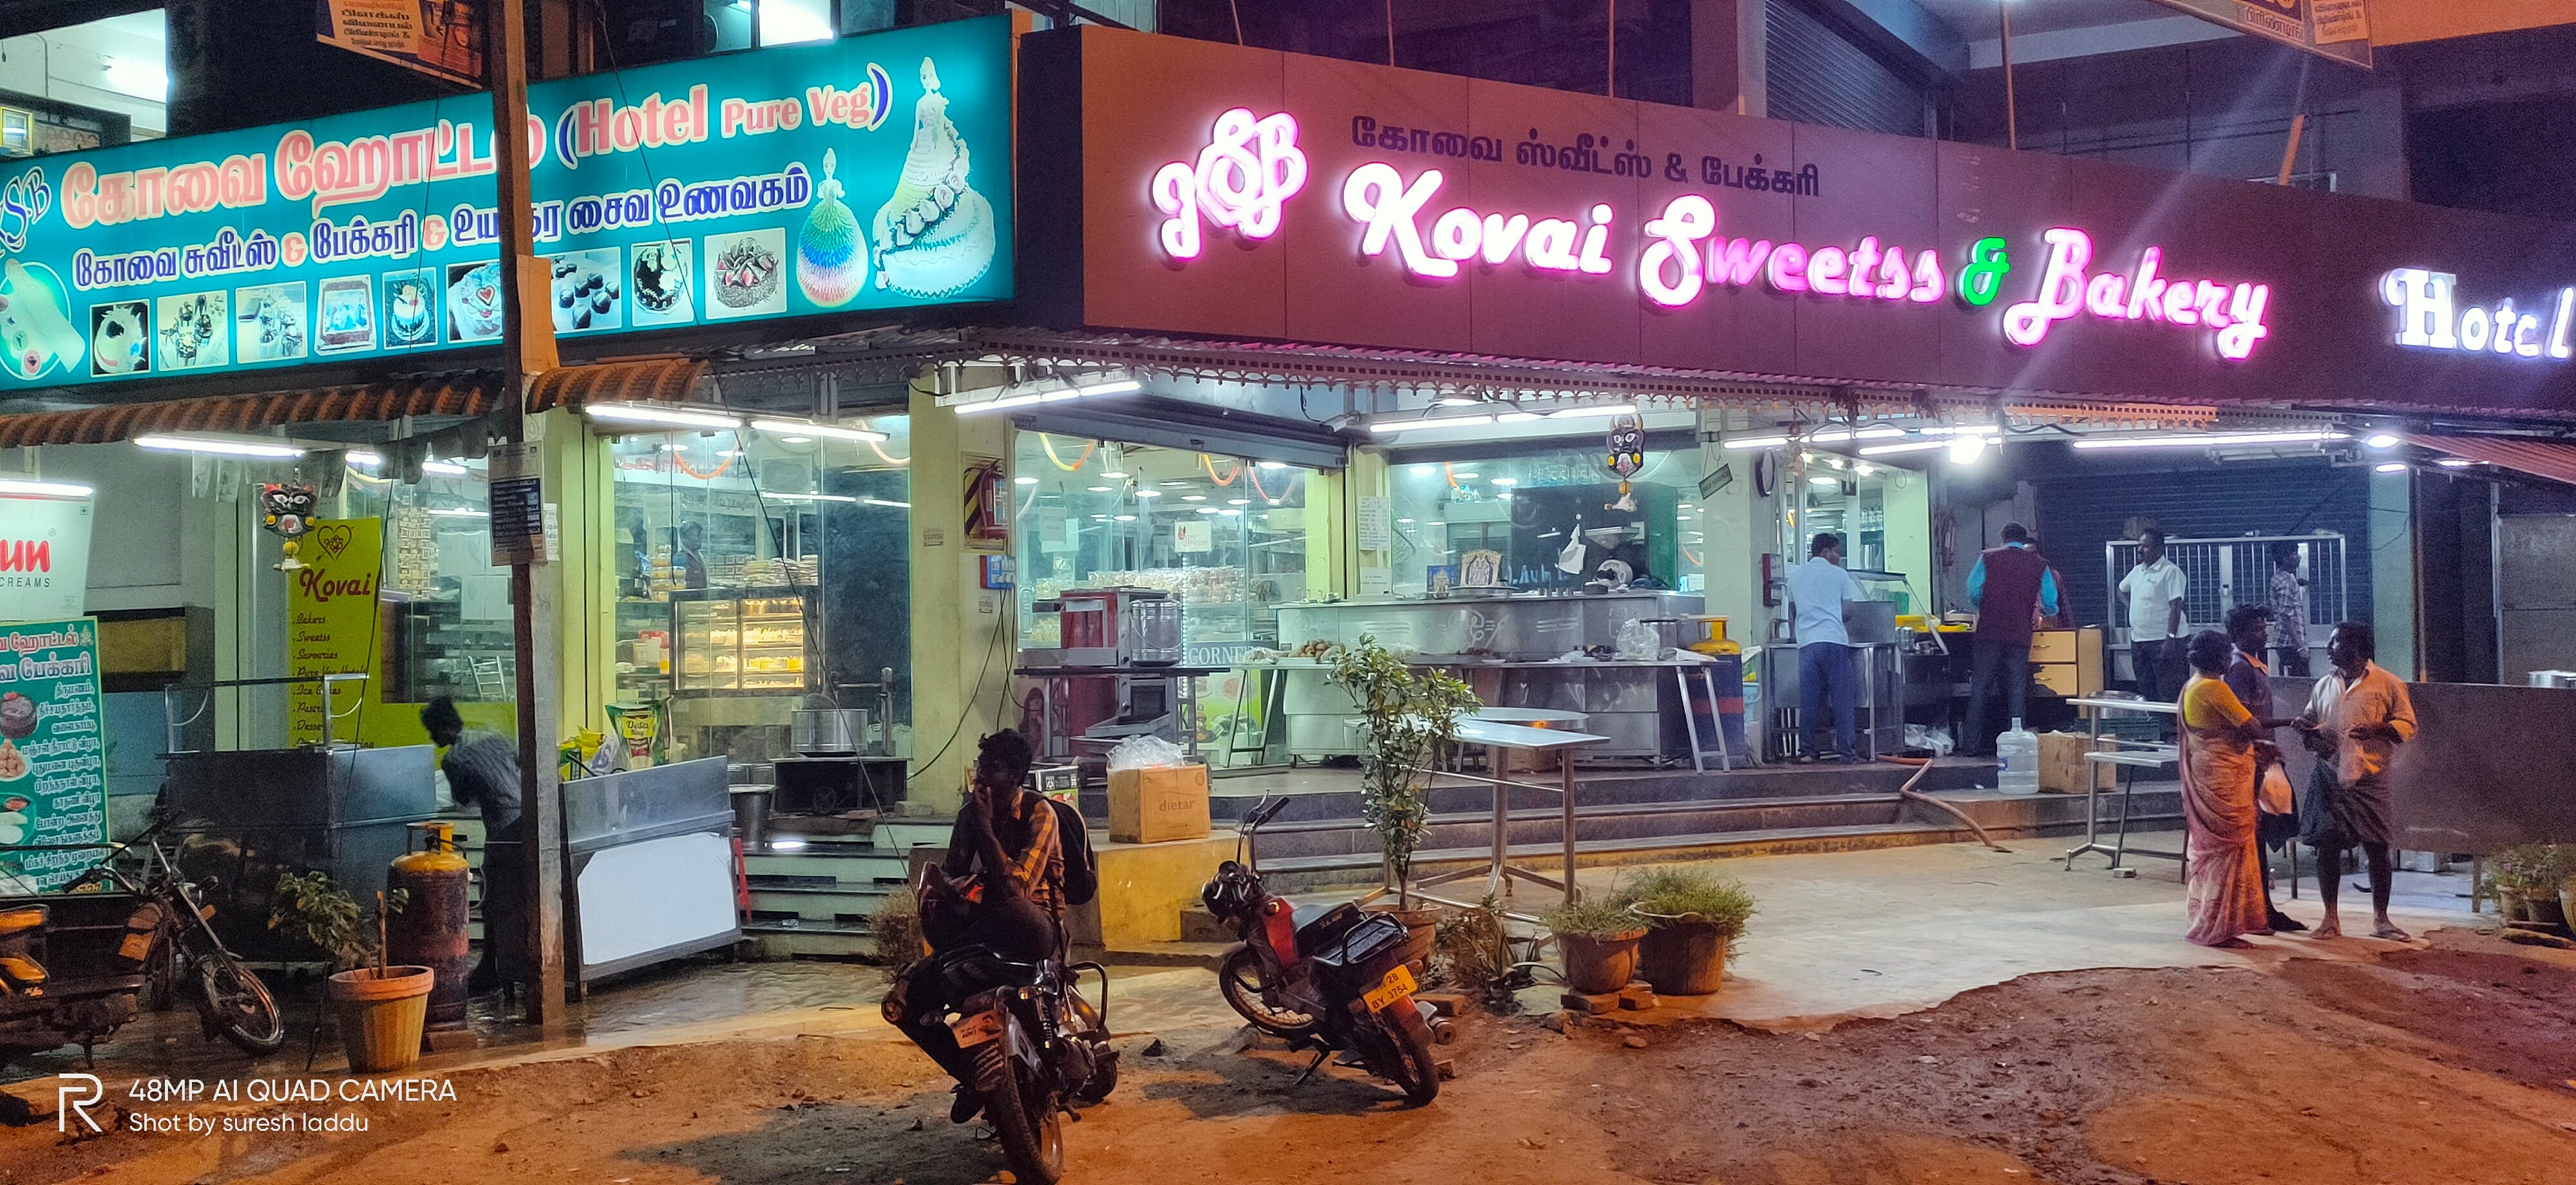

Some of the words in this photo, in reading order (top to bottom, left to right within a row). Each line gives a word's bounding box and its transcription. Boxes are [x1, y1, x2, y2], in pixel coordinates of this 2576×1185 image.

[556, 84, 708, 169] (Hotel
[721, 97, 802, 138] Pure
[806, 62, 893, 132] Veg)
[1352, 115, 1502, 162] கோவை
[1516, 128, 1653, 178] ஸ்வீட்ஸ்
[1664, 153, 1688, 184] &
[1701, 153, 1820, 197] பேக்கரி
[61, 153, 266, 229] கோவை
[73, 247, 180, 291] கோவை
[281, 232, 308, 267] &
[310, 209, 417, 263] பேக்கரி
[421, 214, 448, 250] &
[565, 189, 653, 230] சைவ
[656, 161, 812, 223] உணவகம்
[1343, 161, 1614, 278] Kovai
[1639, 194, 1946, 307] Sweetss
[1956, 236, 2010, 306] &
[2003, 227, 2269, 360] Bakery
[299, 568, 371, 602] Kovai
[10, 623, 79, 657] ஹோட்டல்
[1188, 647, 1251, 665] CORNE
[627, 721, 649, 729] Dosa
[1387, 973, 1399, 984] 28
[1372, 996, 1385, 1009] BY
[1387, 983, 1408, 1000] 3754
